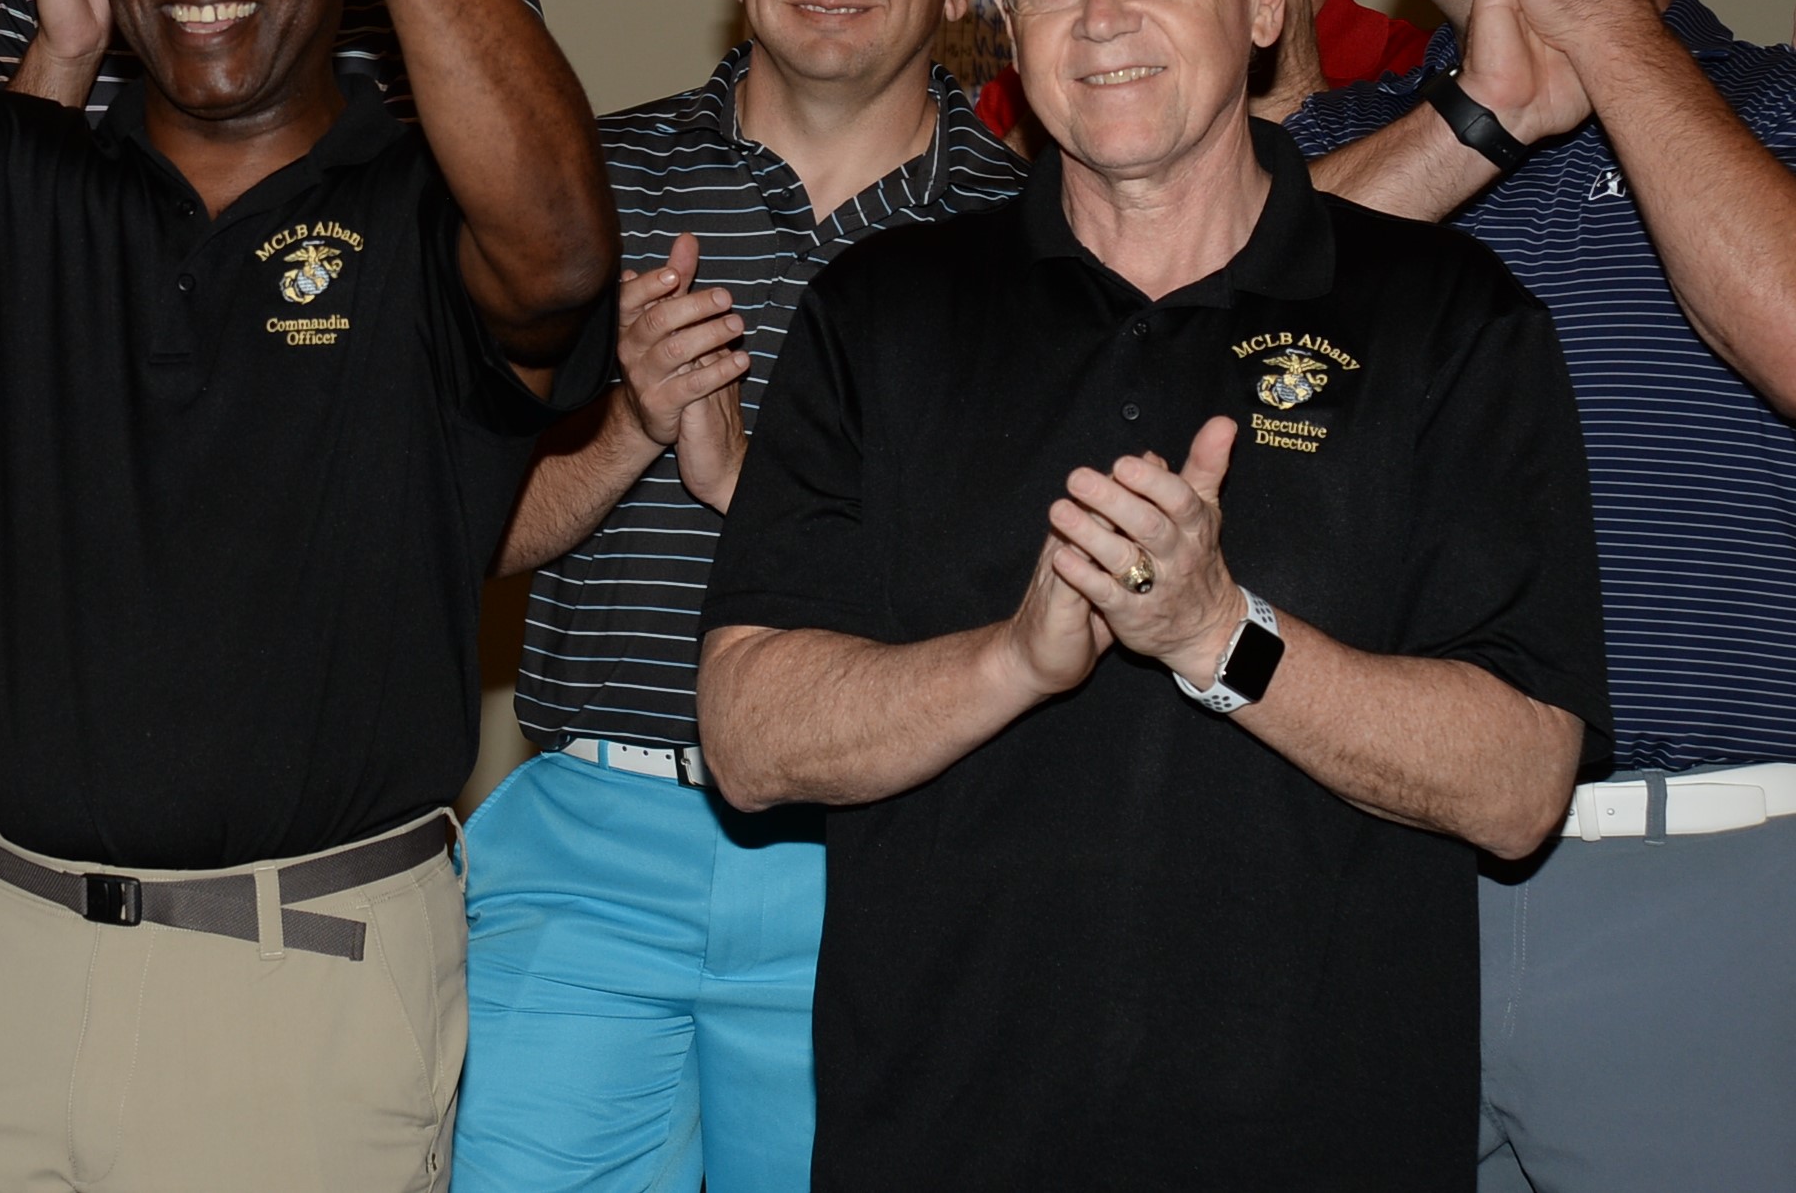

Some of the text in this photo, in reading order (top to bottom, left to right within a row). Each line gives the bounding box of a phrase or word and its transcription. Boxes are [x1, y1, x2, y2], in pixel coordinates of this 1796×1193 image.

[255, 224, 308, 261] MCLB
[266, 314, 350, 333] Commandin
[287, 331, 338, 346] Officer
[1231, 332, 1361, 371] MCLB Albany
[1250, 413, 1328, 439] Executive
[1255, 430, 1320, 453] Director
